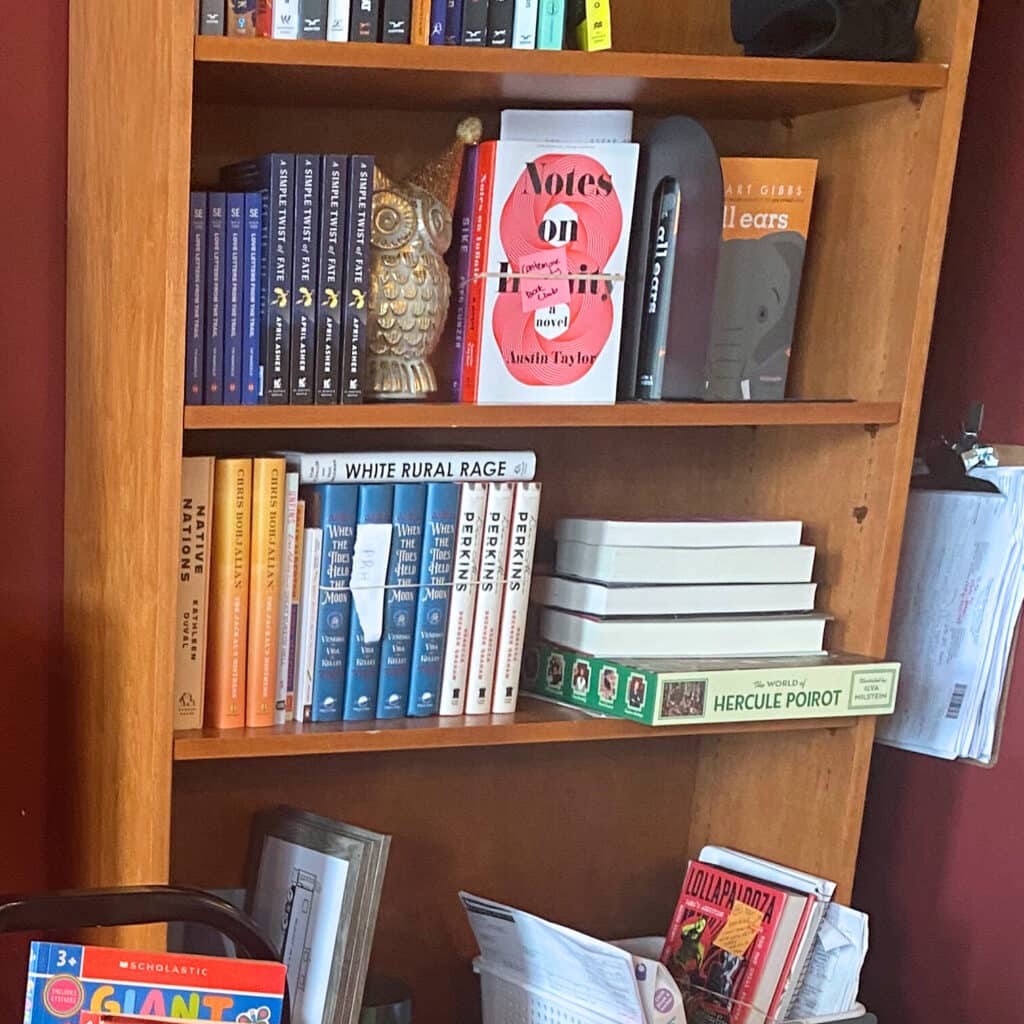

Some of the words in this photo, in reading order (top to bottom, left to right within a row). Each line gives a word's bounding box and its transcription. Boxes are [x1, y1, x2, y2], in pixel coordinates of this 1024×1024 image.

[278, 169, 288, 206] SIMPLE
[304, 169, 313, 206] SIMPLE
[330, 171, 340, 207] SIMPLE
[358, 172, 368, 208] SIMPLE
[522, 162, 613, 197] Notes
[760, 184, 802, 196] GIBBS
[194, 209, 203, 217] SE
[213, 208, 222, 217] SE
[231, 208, 240, 217] SE
[249, 208, 258, 217] SE
[740, 212, 789, 230] ears
[277, 209, 286, 242] TWIST
[303, 209, 312, 242] TWIST
[329, 210, 338, 243] TWIST
[356, 213, 366, 244] TWIST
[462, 217, 470, 251] SIKE
[538, 217, 578, 243] on
[654, 226, 668, 259] all
[276, 257, 285, 281] FATE
[301, 257, 310, 280] FATE
[328, 259, 336, 282] FATE
[354, 259, 363, 283] FATE
[648, 262, 661, 314] ears
[536, 312, 569, 328] novel
[274, 343, 282, 371] ASHER
[506, 351, 549, 365] Austin
[552, 351, 597, 371] Taylor
[346, 462, 396, 479] WHITE
[401, 462, 454, 479] RURAL
[460, 461, 507, 477] RAGE
[235, 468, 244, 508] CHRIS
[269, 468, 278, 507] CHRIS
[181, 498, 193, 582] NATIONS
[195, 506, 205, 574] NATIVE
[328, 524, 353, 538] WHEN
[395, 523, 421, 537] WHEN
[430, 522, 455, 535] WHEN
[234, 512, 243, 589] BOHJALIAN
[267, 511, 276, 588] BOHJALIAN
[332, 541, 348, 550] THE
[400, 540, 415, 549] THE
[435, 538, 448, 547] THE
[456, 512, 475, 592] PERKINS
[482, 512, 500, 592] PERKINS
[510, 511, 528, 592] PERKINS
[328, 552, 350, 565] TIDES
[396, 550, 417, 563] TIDES
[430, 548, 451, 561] TIDES
[328, 564, 349, 578] HELD
[395, 564, 417, 576] HELD
[429, 563, 450, 575] HELD
[322, 590, 347, 605] MOON
[390, 589, 414, 603] MOON
[424, 586, 447, 602] MOON
[190, 600, 199, 661] KATHLEEN
[767, 680, 798, 688] WORLD
[714, 691, 781, 713] HERCULE
[786, 690, 842, 708] POIROT
[685, 868, 777, 925] LOLLAPALOOZA
[56, 950, 77, 967] 3+
[130, 961, 209, 977] SCHOLASTIC
[90, 986, 234, 1021] GIANT
